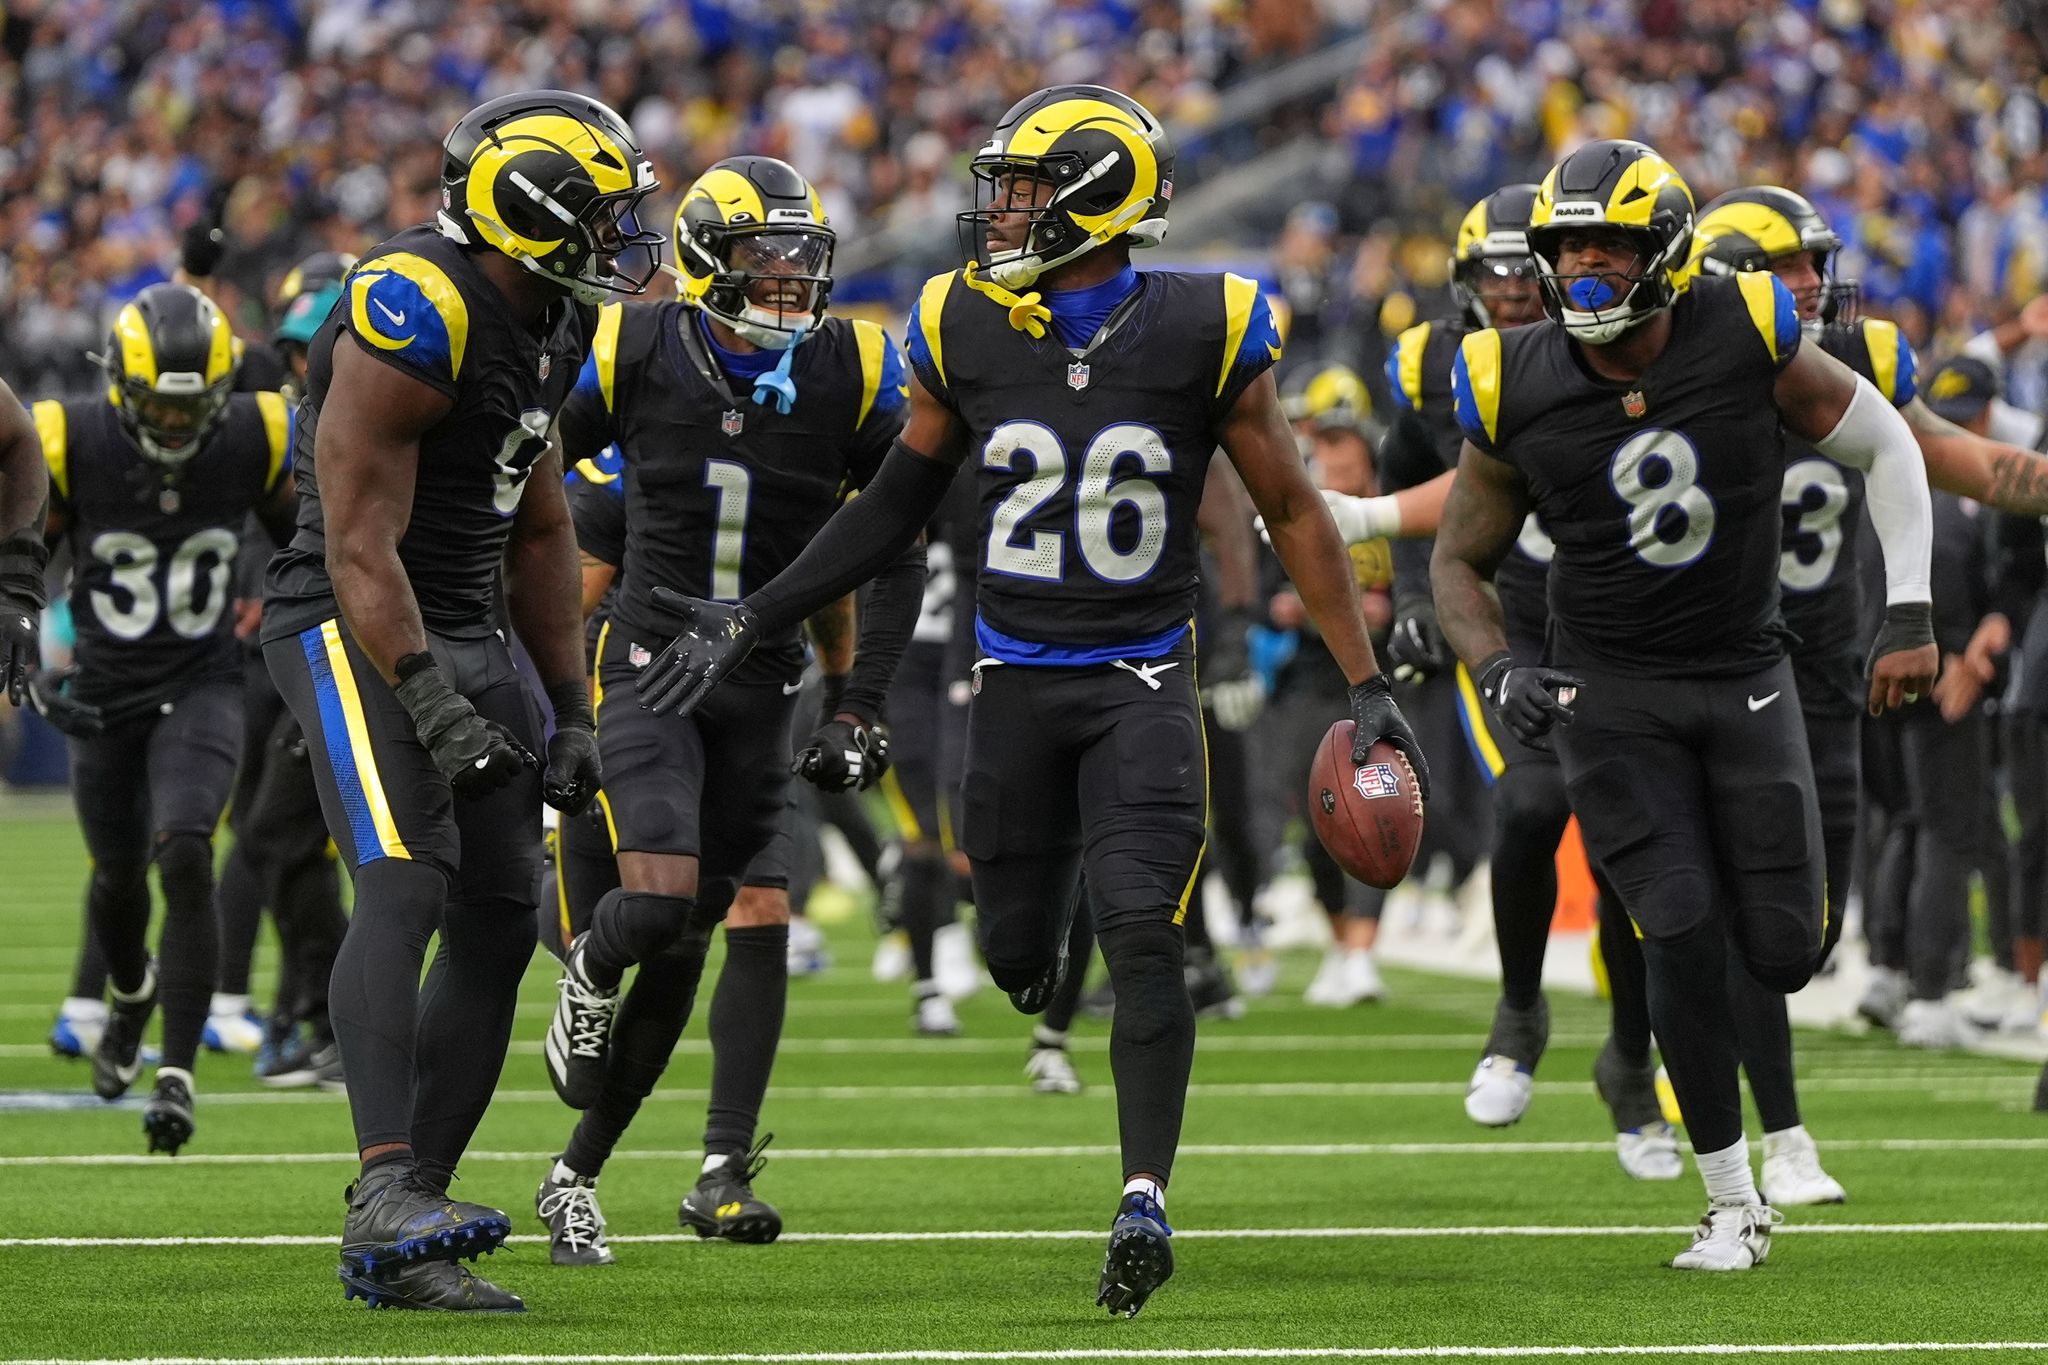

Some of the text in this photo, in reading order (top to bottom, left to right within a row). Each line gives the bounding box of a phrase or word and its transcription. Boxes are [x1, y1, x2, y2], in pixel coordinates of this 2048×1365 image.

[1556, 208, 1595, 216] RAMS
[704, 458, 752, 601] 1
[983, 419, 1173, 584] 26
[1608, 427, 1716, 567] 8
[1778, 457, 1849, 591] 3
[90, 527, 239, 640] 30
[1361, 768, 1381, 794] NFL
